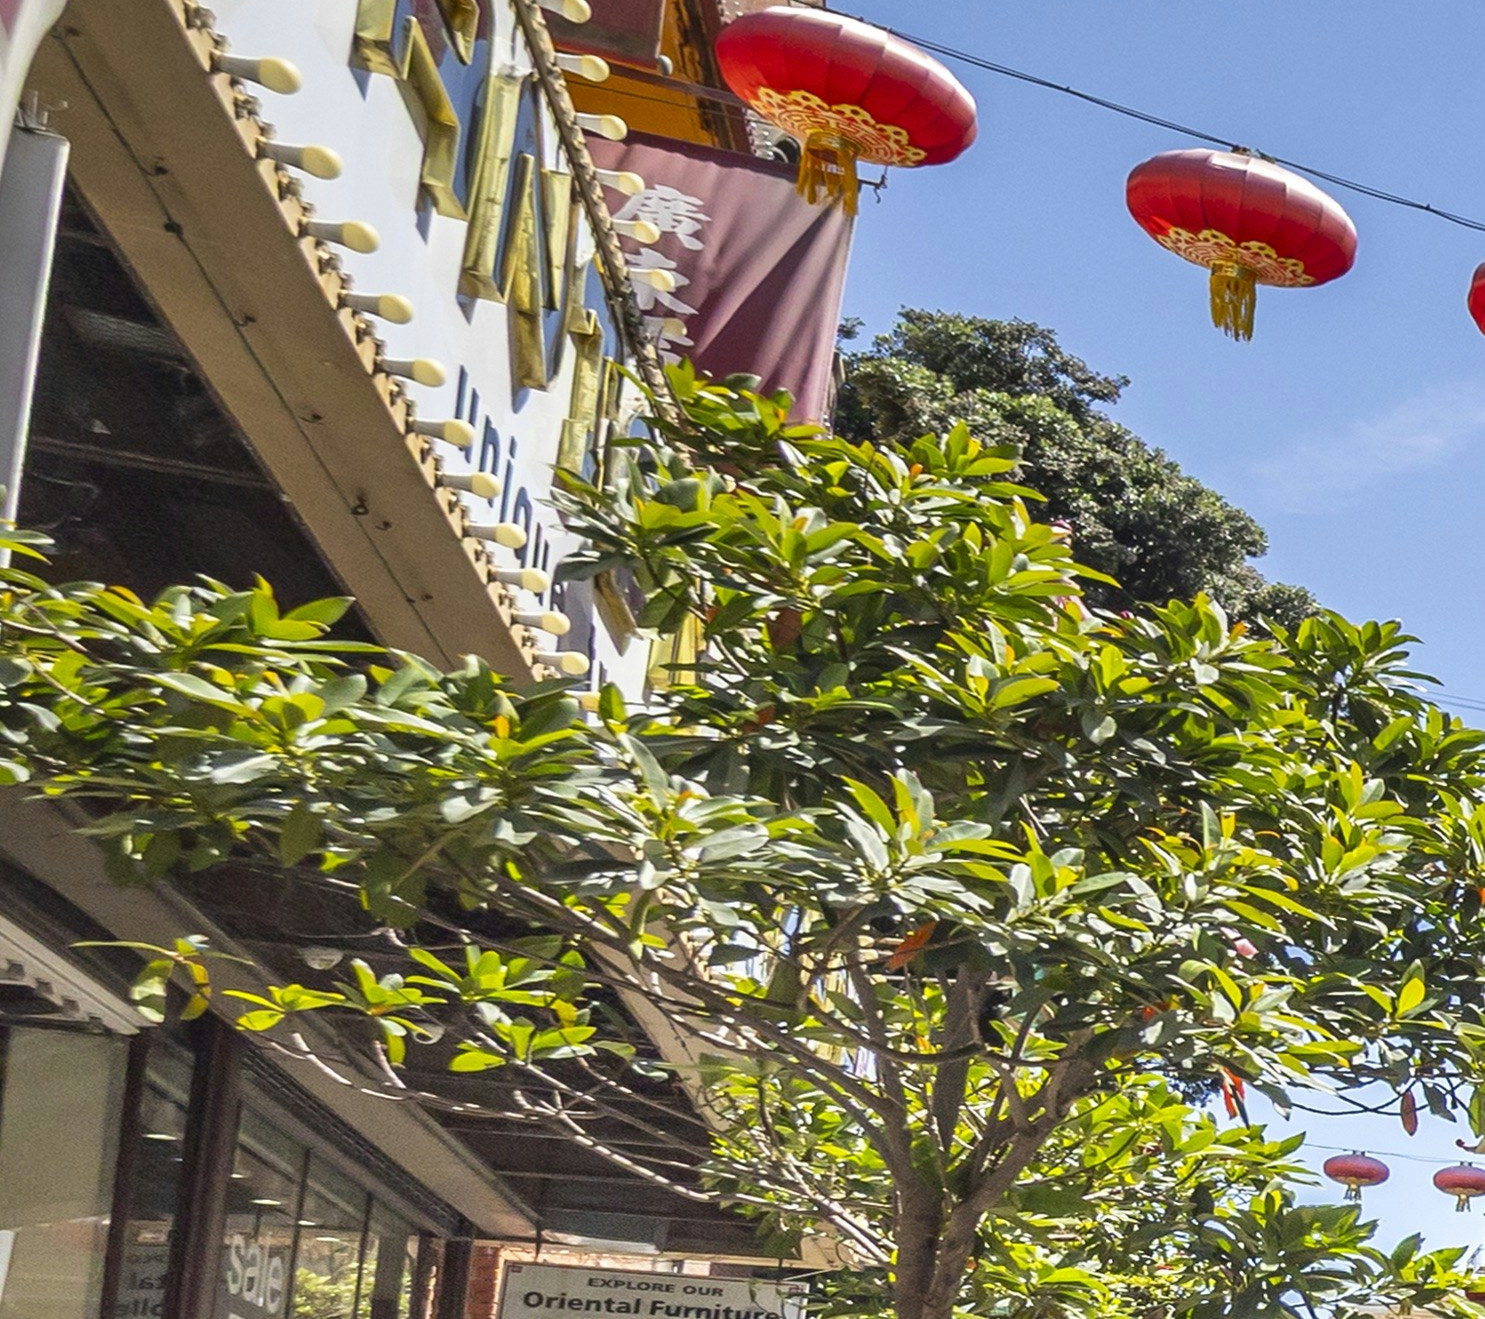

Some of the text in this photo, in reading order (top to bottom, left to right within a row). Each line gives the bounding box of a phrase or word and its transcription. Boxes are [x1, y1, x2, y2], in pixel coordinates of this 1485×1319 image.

[587, 1277, 724, 1298] EXPLORE OUR
[522, 1290, 640, 1316] Oriental
